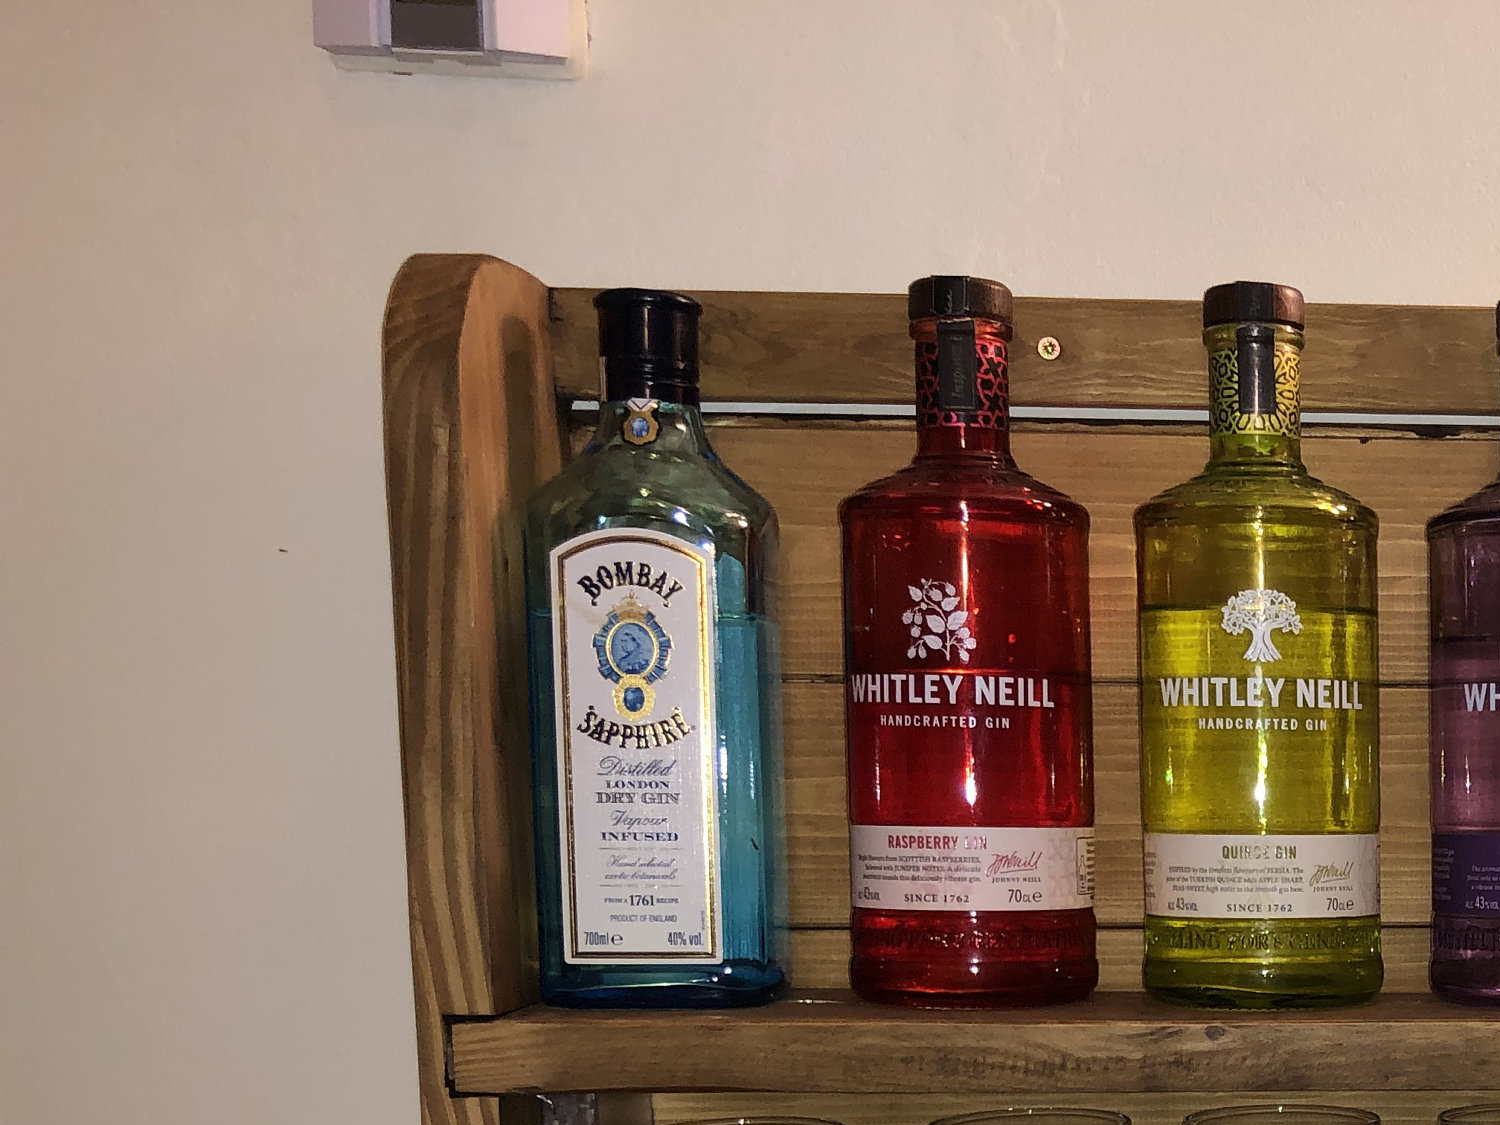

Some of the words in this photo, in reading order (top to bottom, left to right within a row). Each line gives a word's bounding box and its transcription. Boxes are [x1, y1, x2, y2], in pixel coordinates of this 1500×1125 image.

[577, 561, 685, 607] BOMBAY
[851, 674, 963, 704] WHITLEY
[975, 675, 1055, 708] NEILL
[1160, 677, 1285, 708] WHITLEY
[1296, 679, 1363, 710] NEILL
[576, 705, 691, 750] SAPPHIRE
[880, 714, 976, 728] HANDCRAFTED
[985, 716, 1010, 729] GIN
[1198, 718, 1298, 731] HANDCRAFTED
[1305, 719, 1327, 731] GIN
[597, 755, 677, 776] Distilled
[606, 780, 670, 789] LONDON
[596, 792, 638, 804] DRY
[641, 792, 680, 804] GIN
[611, 810, 668, 830] Vapour
[601, 832, 679, 841] INFUSED
[888, 834, 958, 850] RASPBERRY
[964, 835, 987, 850] GIN
[1222, 845, 1270, 860] QUINCE
[1275, 845, 1297, 860] GIN
[629, 895, 655, 906] 1761
[904, 894, 938, 902] SINCE
[943, 894, 969, 903] 1762
[1226, 904, 1262, 912] SINCE
[1268, 904, 1293, 912] 1762
[610, 914, 638, 922] PRODUCT
[639, 914, 647, 922] OF
[649, 914, 677, 922] ENGLAND
[584, 932, 609, 946] 700ml
[667, 932, 687, 946] 40%
[689, 932, 705, 946] vol.
